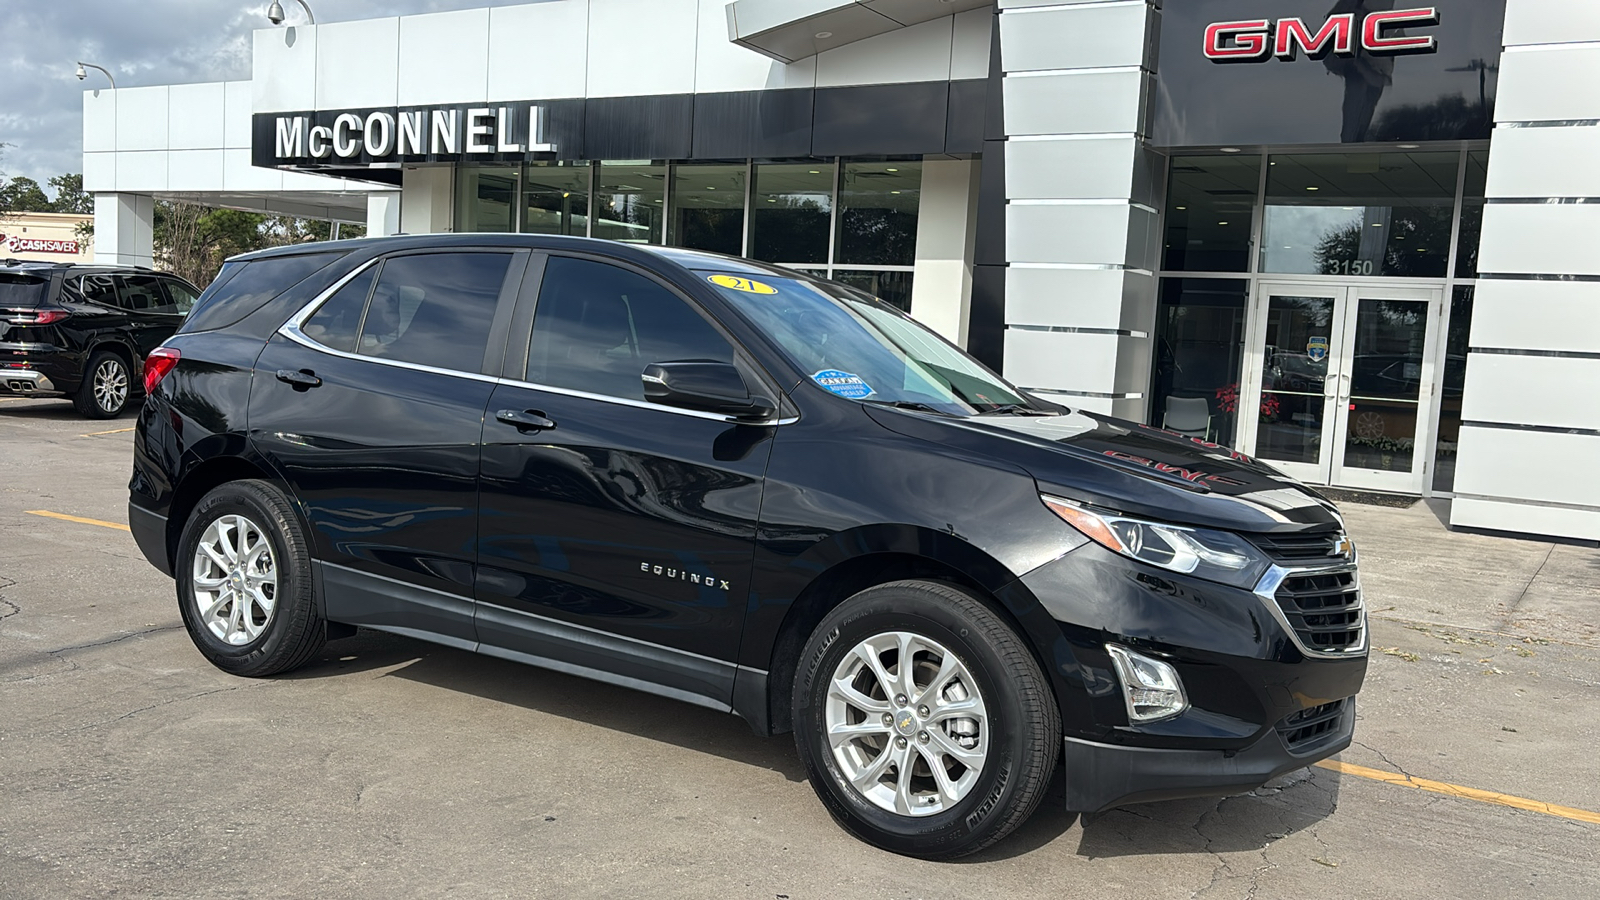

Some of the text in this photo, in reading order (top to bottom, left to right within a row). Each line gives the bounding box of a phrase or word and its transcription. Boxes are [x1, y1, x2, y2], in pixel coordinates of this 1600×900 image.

[1203, 7, 1436, 58] GMC
[275, 106, 556, 158] McCONNELL
[20, 240, 76, 252] CASHSAVER
[728, 277, 757, 291] 21
[1329, 259, 1373, 275] 3150
[640, 562, 730, 590] EQUINOX
[804, 628, 838, 687] MICHELIN
[968, 766, 1009, 828] MICHELIN
